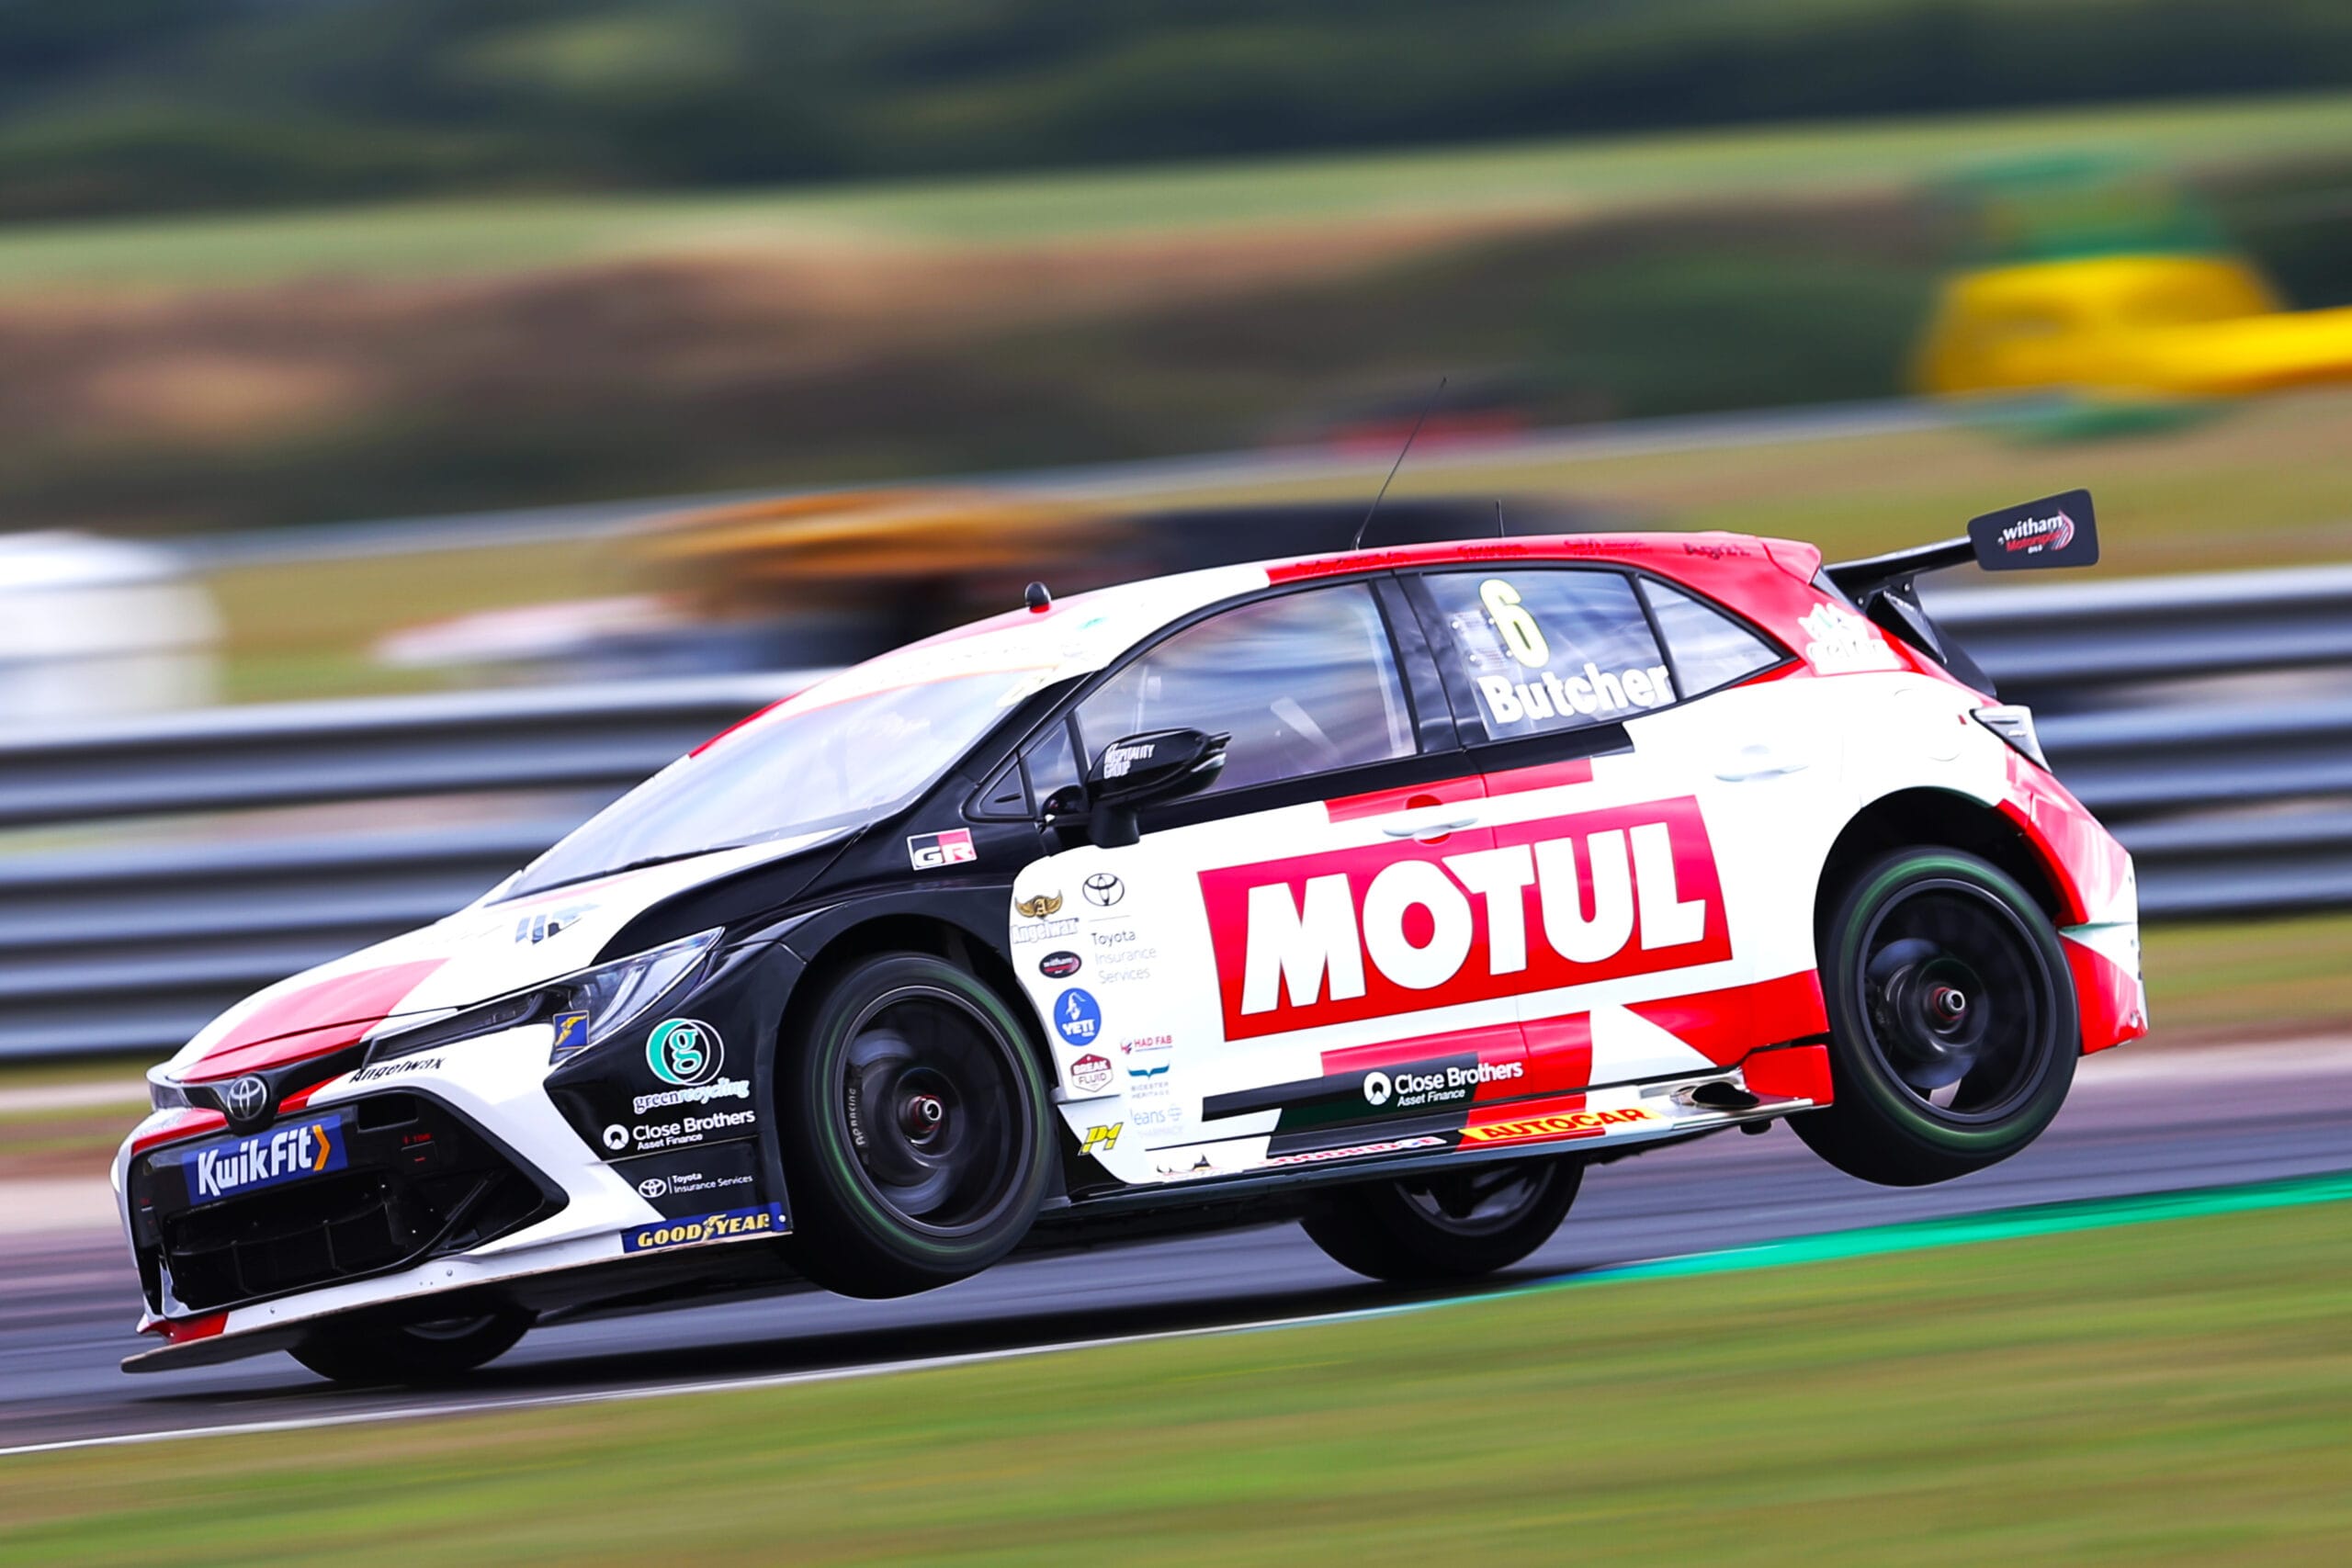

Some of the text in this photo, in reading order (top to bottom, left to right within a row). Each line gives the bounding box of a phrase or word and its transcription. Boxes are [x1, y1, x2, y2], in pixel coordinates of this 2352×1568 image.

[2003, 515, 2063, 540] witham
[1479, 579, 1550, 668] 6
[1477, 662, 1672, 724] Butcher
[913, 839, 977, 867] GR
[1241, 822, 1706, 1016] MOTUL
[1091, 931, 1136, 947] Toyota
[1095, 947, 1158, 965] Insurance
[1099, 966, 1151, 984] Services
[1062, 1020, 1095, 1036] YETI
[1156, 1034, 1172, 1045] FAB
[349, 1057, 447, 1084] Angelwax
[1073, 1059, 1109, 1075] BREAK
[1395, 1061, 1523, 1094] Close Brothers
[1079, 1073, 1107, 1084] FLUID
[1397, 1089, 1465, 1108] Asset Finance
[632, 1111, 755, 1141] Close Brothers
[1480, 1108, 1651, 1138] AUTOCAR
[637, 1134, 704, 1151] Asset Finance
[1078, 1122, 1125, 1156] P1
[672, 1173, 703, 1184] Toyota
[673, 1175, 753, 1193] Insurance Services
[638, 1214, 771, 1248] GOODYEAR
